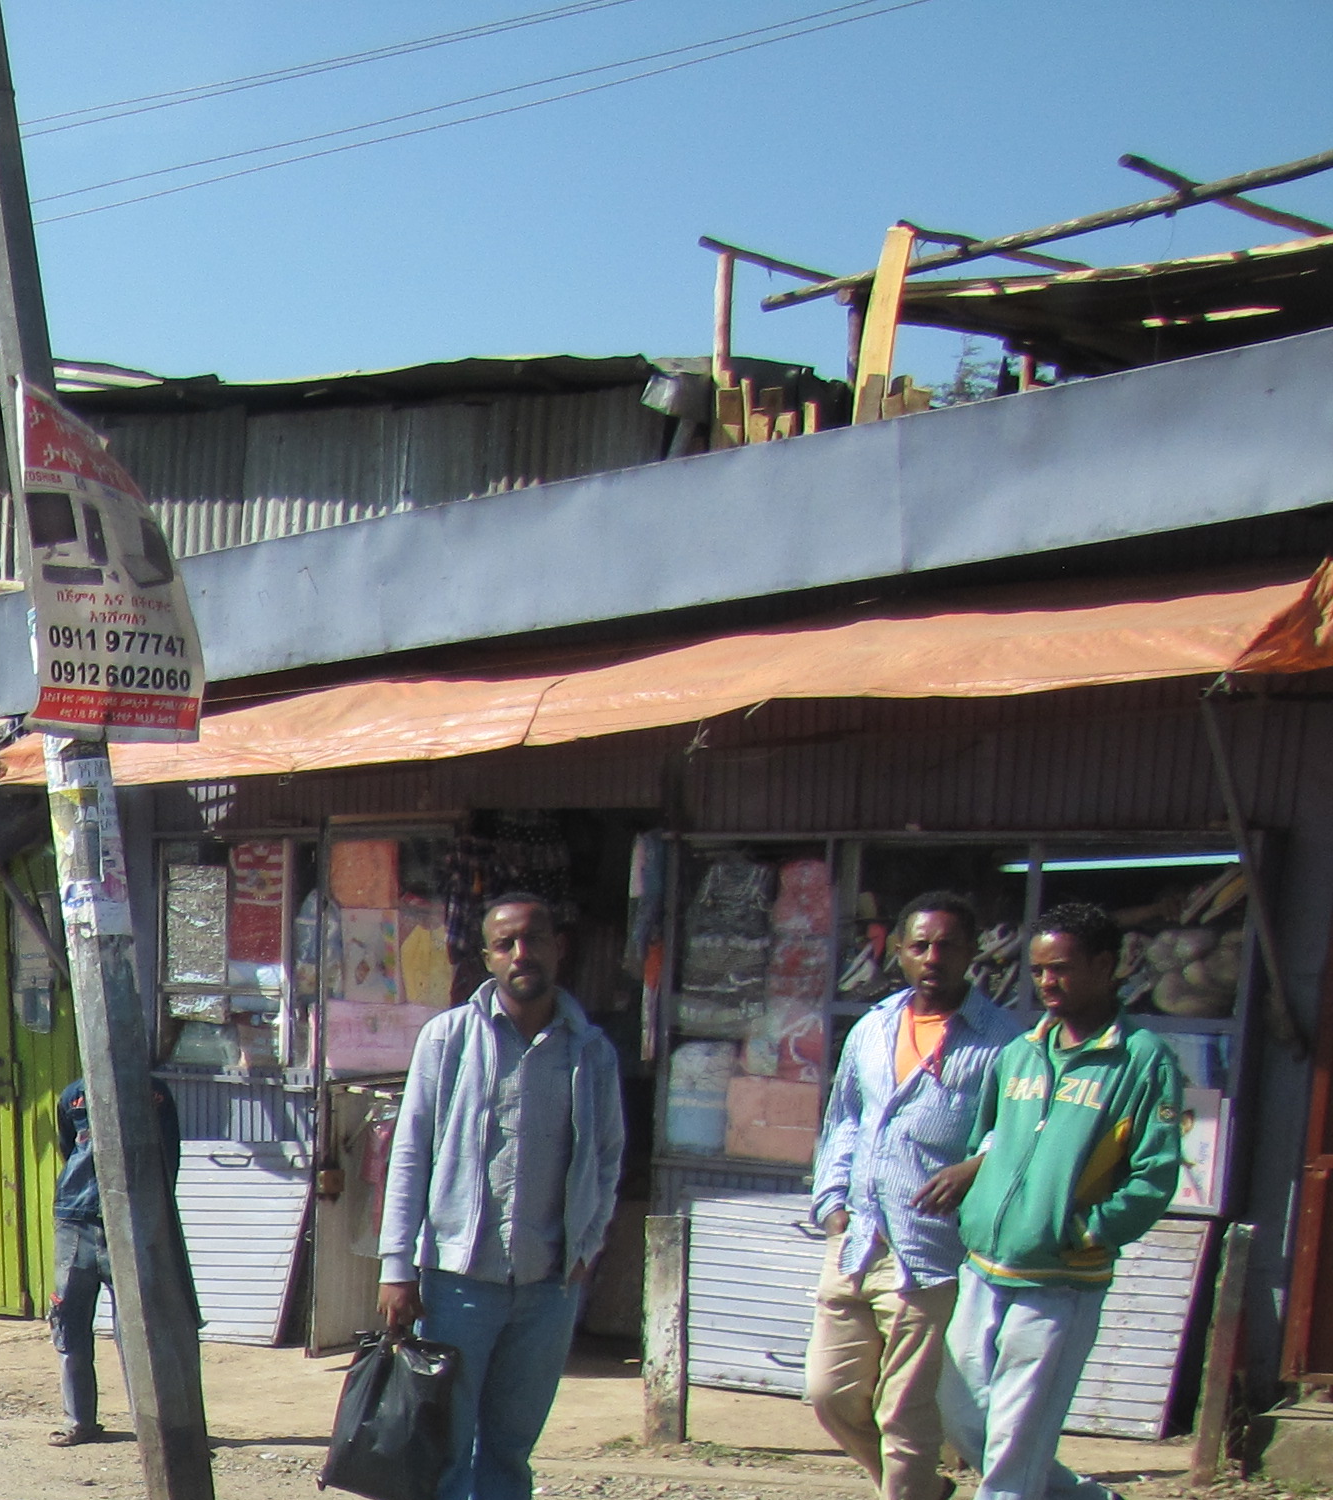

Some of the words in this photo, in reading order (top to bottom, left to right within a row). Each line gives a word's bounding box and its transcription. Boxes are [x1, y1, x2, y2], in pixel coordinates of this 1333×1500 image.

[48, 625, 96, 651] 0911
[105, 629, 186, 658] 977747
[50, 659, 101, 686] 0912
[105, 664, 191, 692] 602060
[1004, 1076, 1102, 1110] BRAZIL
